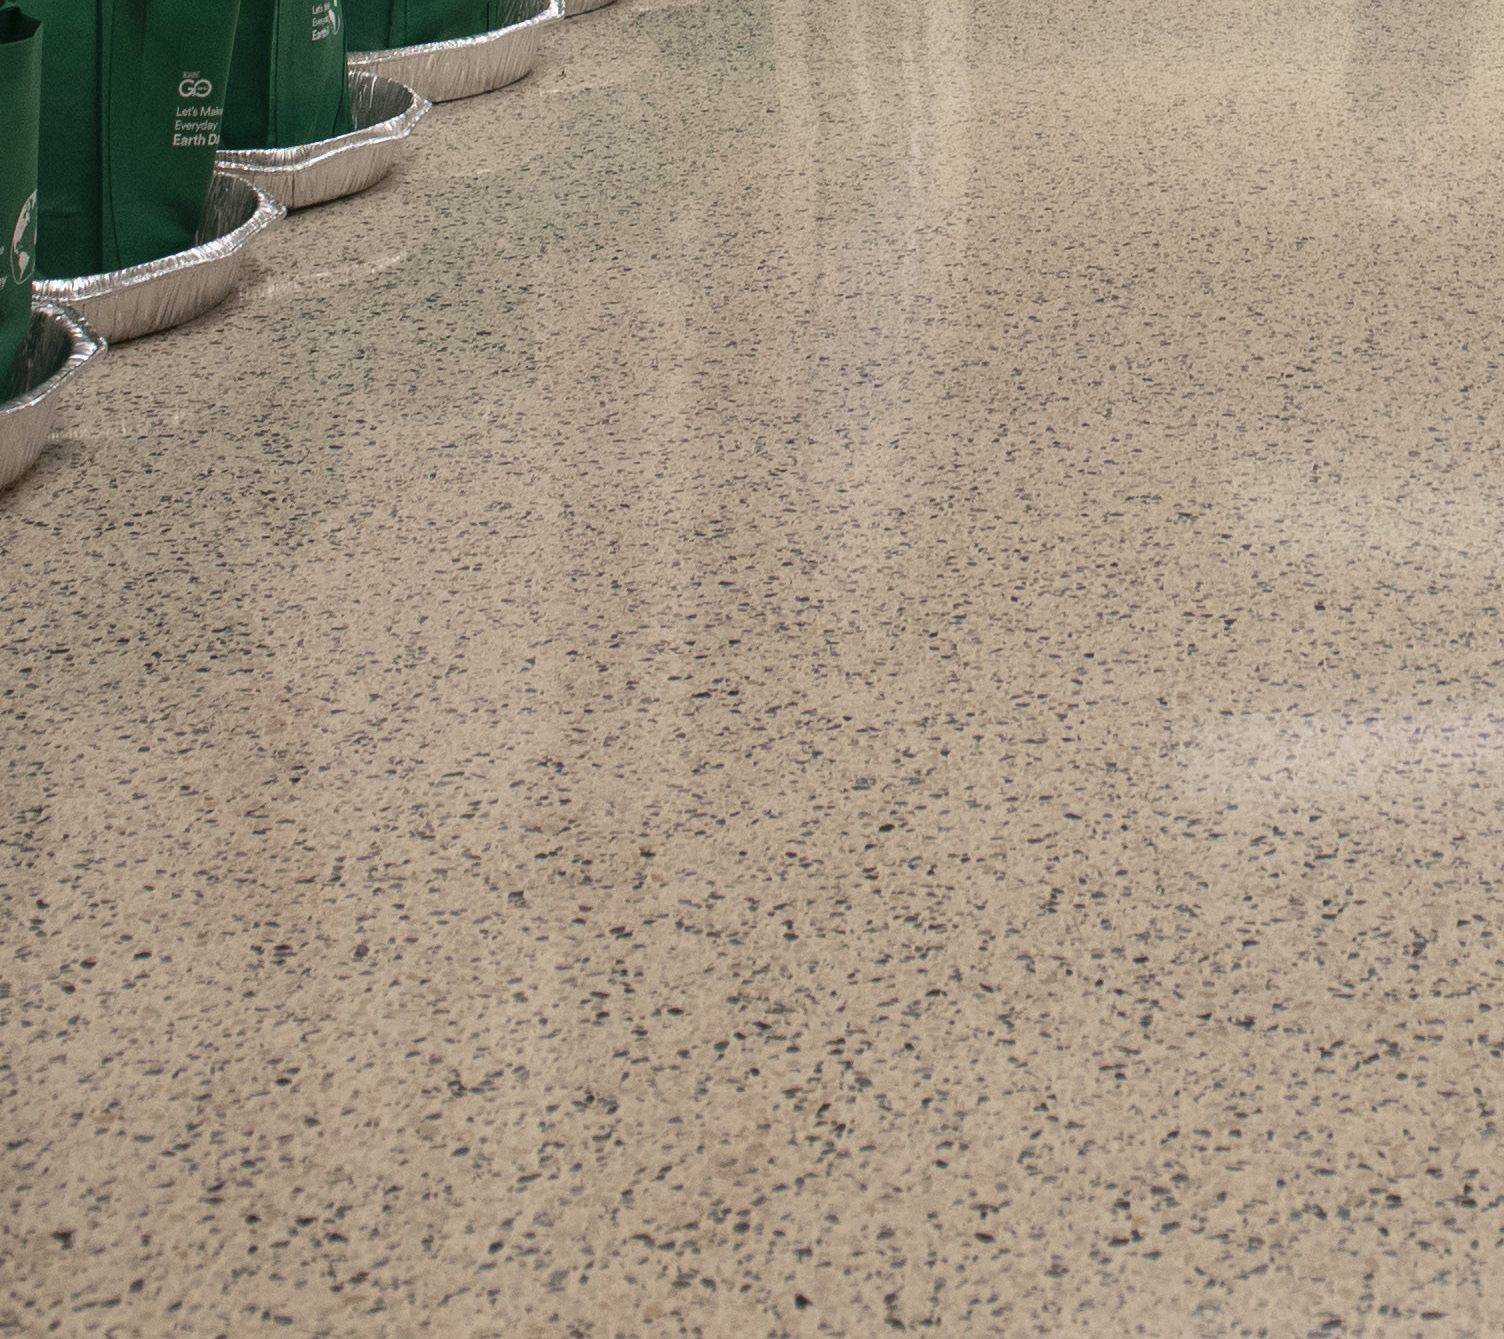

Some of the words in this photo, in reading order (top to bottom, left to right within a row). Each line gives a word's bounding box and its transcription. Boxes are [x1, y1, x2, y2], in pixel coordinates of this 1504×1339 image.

[178, 78, 213, 99] GO
[175, 106, 198, 118] Let's
[173, 119, 218, 132] Everyday
[172, 133, 206, 147] Earth
